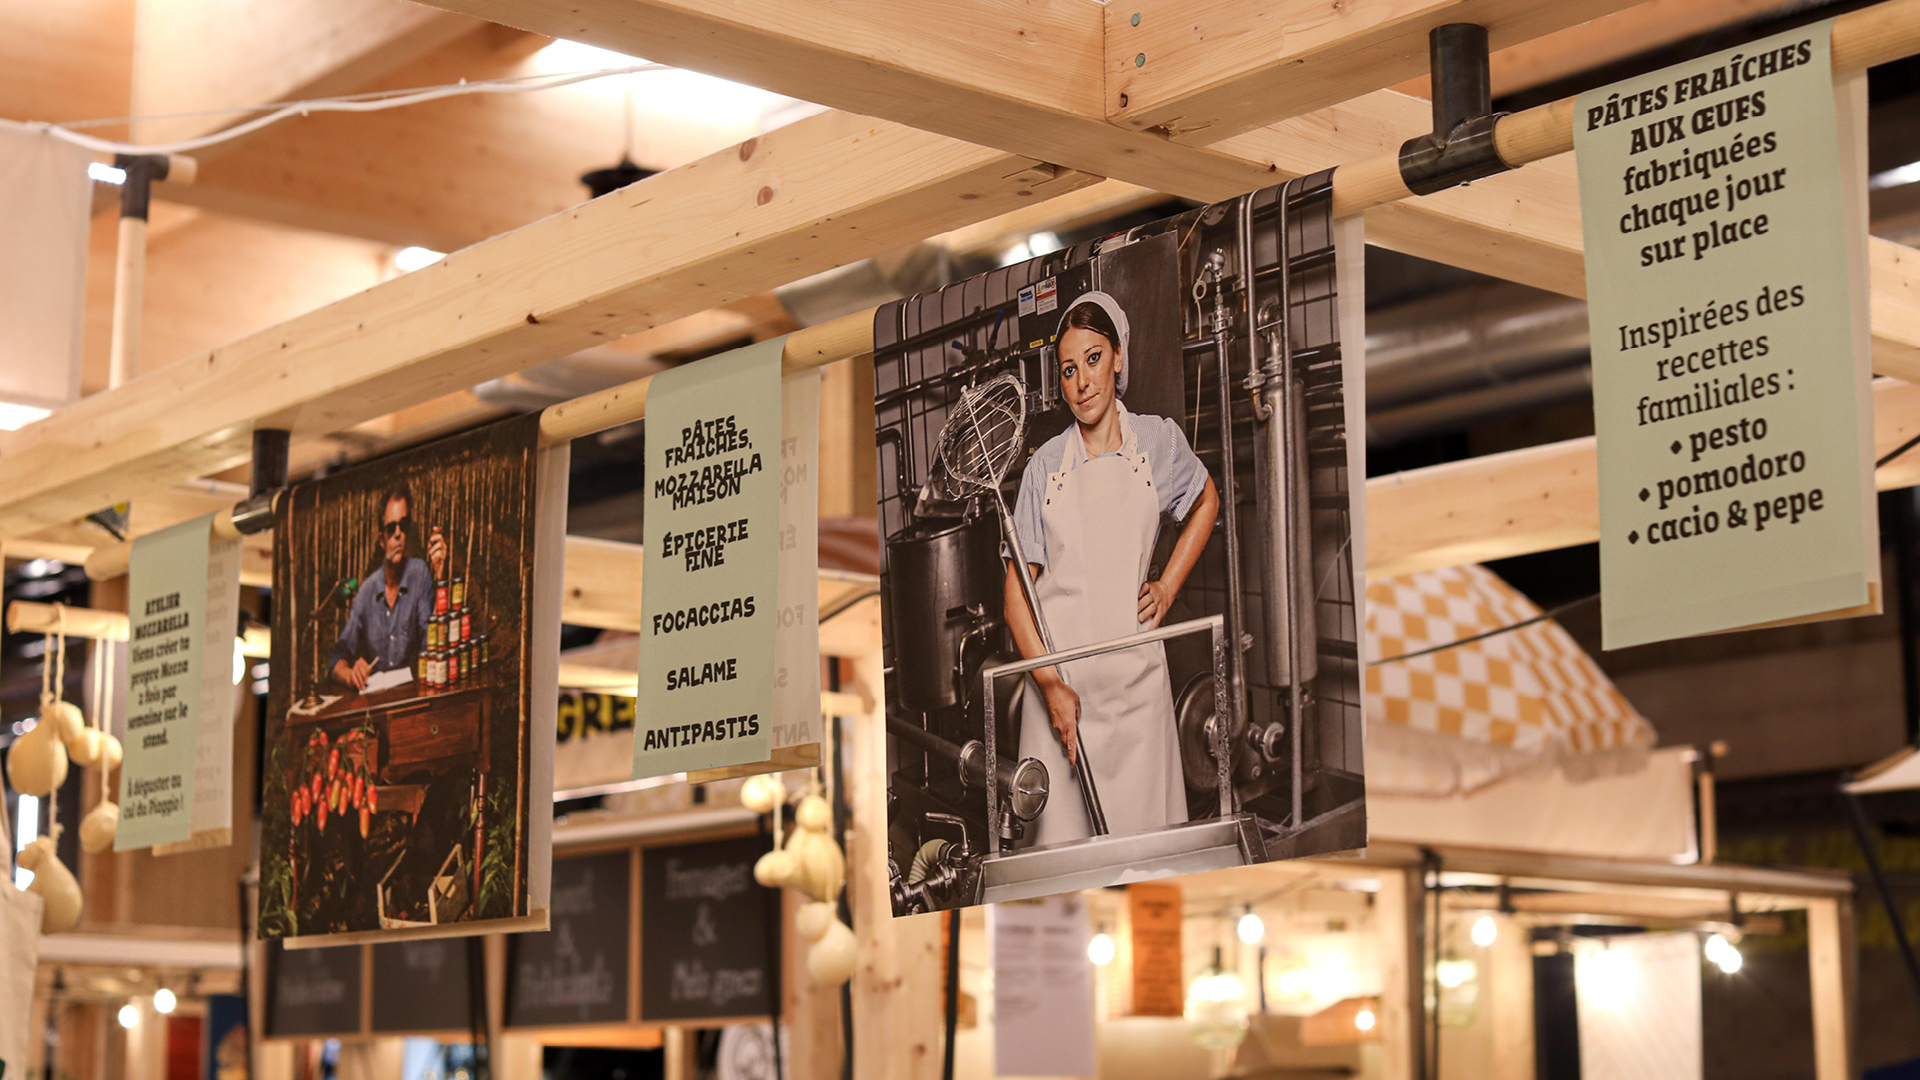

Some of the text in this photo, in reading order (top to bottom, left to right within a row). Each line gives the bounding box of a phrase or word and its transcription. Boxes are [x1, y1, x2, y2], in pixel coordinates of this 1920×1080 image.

[1587, 39, 1812, 132] PÂTES FRAÎCHES
[1629, 91, 1767, 155] AUX ŒUFS
[1623, 131, 1777, 195] fabriquées
[1620, 167, 1786, 234] chaque jour
[1640, 213, 1769, 267] sur place
[1618, 284, 1805, 352] Inspirées des
[1656, 335, 1769, 381] recettes
[1637, 371, 1781, 426] familiales
[682, 415, 736, 447] PÂTES
[1689, 417, 1768, 462] pesto
[655, 453, 762, 499] MOZZARELLA
[672, 475, 741, 511] MAISON
[1657, 449, 1806, 509] pomodoro
[1646, 488, 1824, 545] cacio & pepe
[662, 518, 749, 558] ÉPICERIE
[685, 544, 724, 572] FINE
[145, 592, 180, 615] ATELIER
[653, 596, 755, 636] FOCACCIAS
[136, 612, 189, 640] MOZZARELLA
[130, 668, 159, 691] propre
[162, 685, 177, 704] par
[666, 658, 737, 691] SALAME
[164, 706, 178, 723] sur
[179, 702, 188, 718] le
[644, 714, 759, 751] ANTIPASTIS
